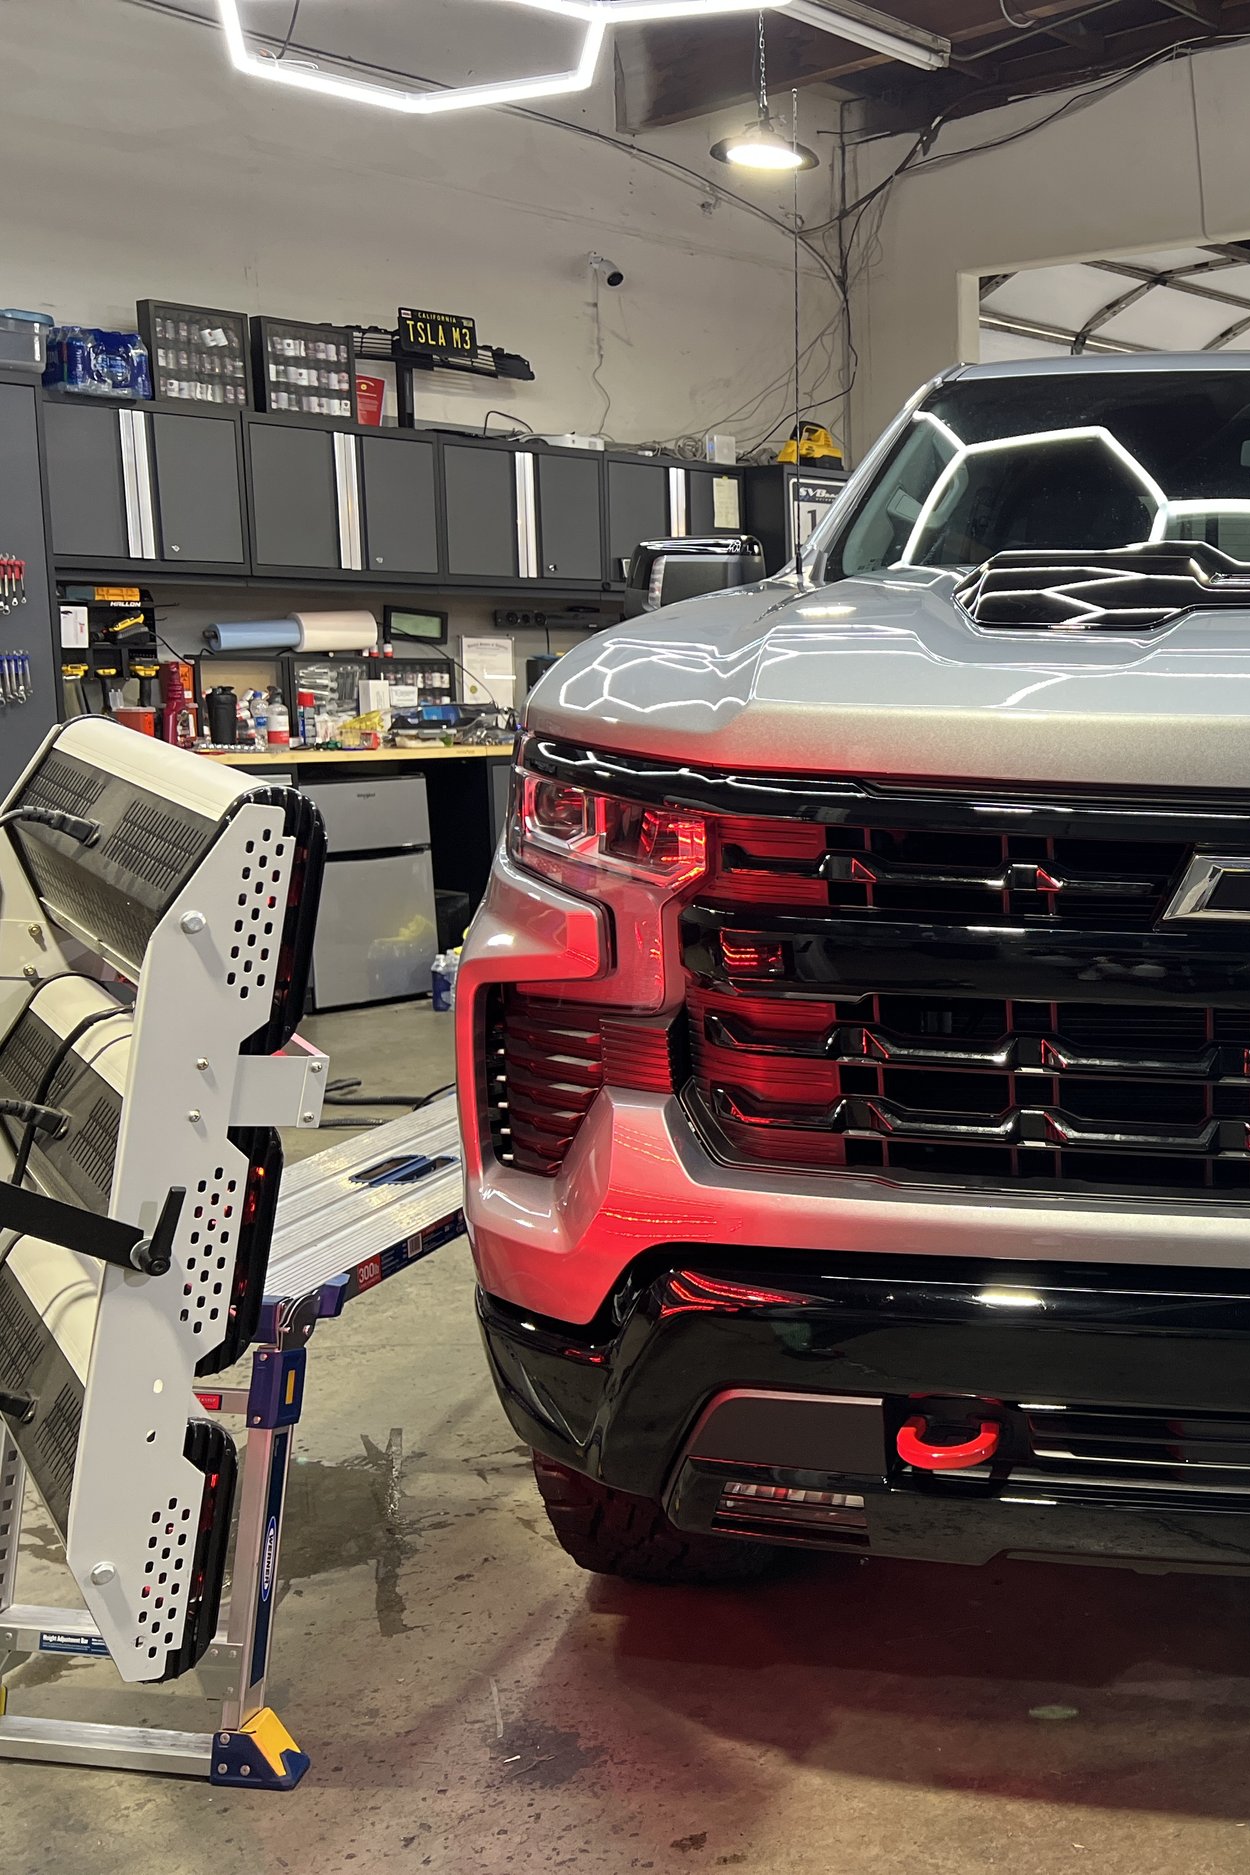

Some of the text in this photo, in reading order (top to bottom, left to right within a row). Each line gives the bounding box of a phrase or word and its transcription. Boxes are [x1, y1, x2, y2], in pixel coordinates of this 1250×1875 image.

[417, 312, 457, 324] CALIFORNIA
[406, 320, 472, 350] TSLA M3
[264, 1533, 275, 1585] WERNER
